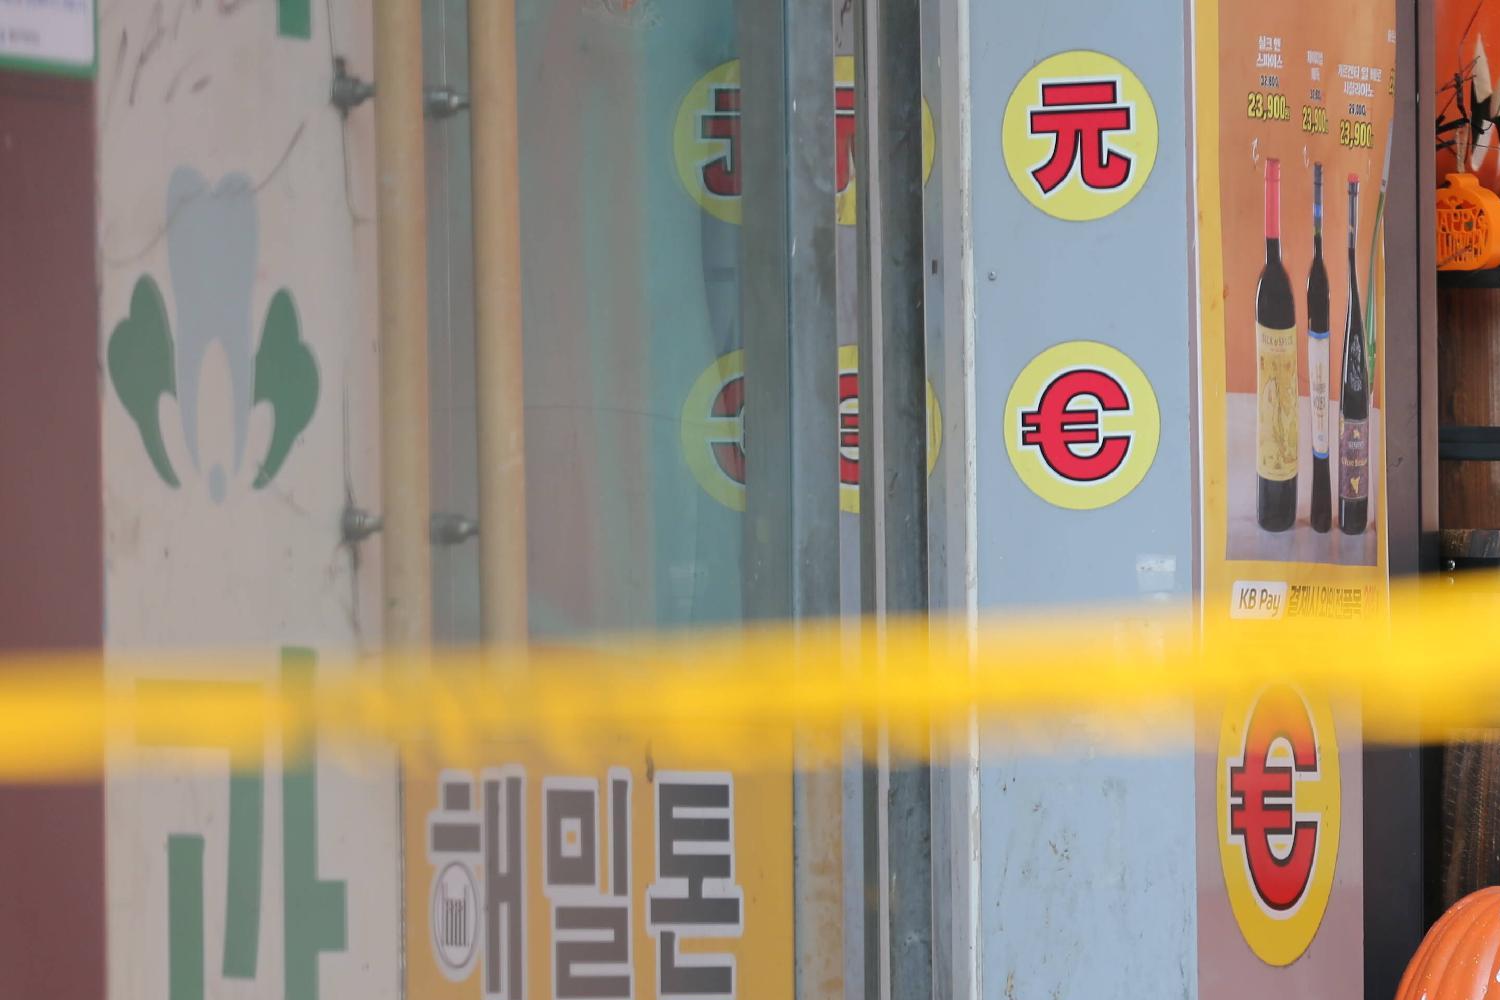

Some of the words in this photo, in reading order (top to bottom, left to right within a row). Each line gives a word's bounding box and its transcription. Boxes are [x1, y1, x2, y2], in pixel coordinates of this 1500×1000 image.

[1028, 78, 1132, 196] 元
[1238, 588, 1257, 610] KB
[1259, 588, 1281, 617] Pay
